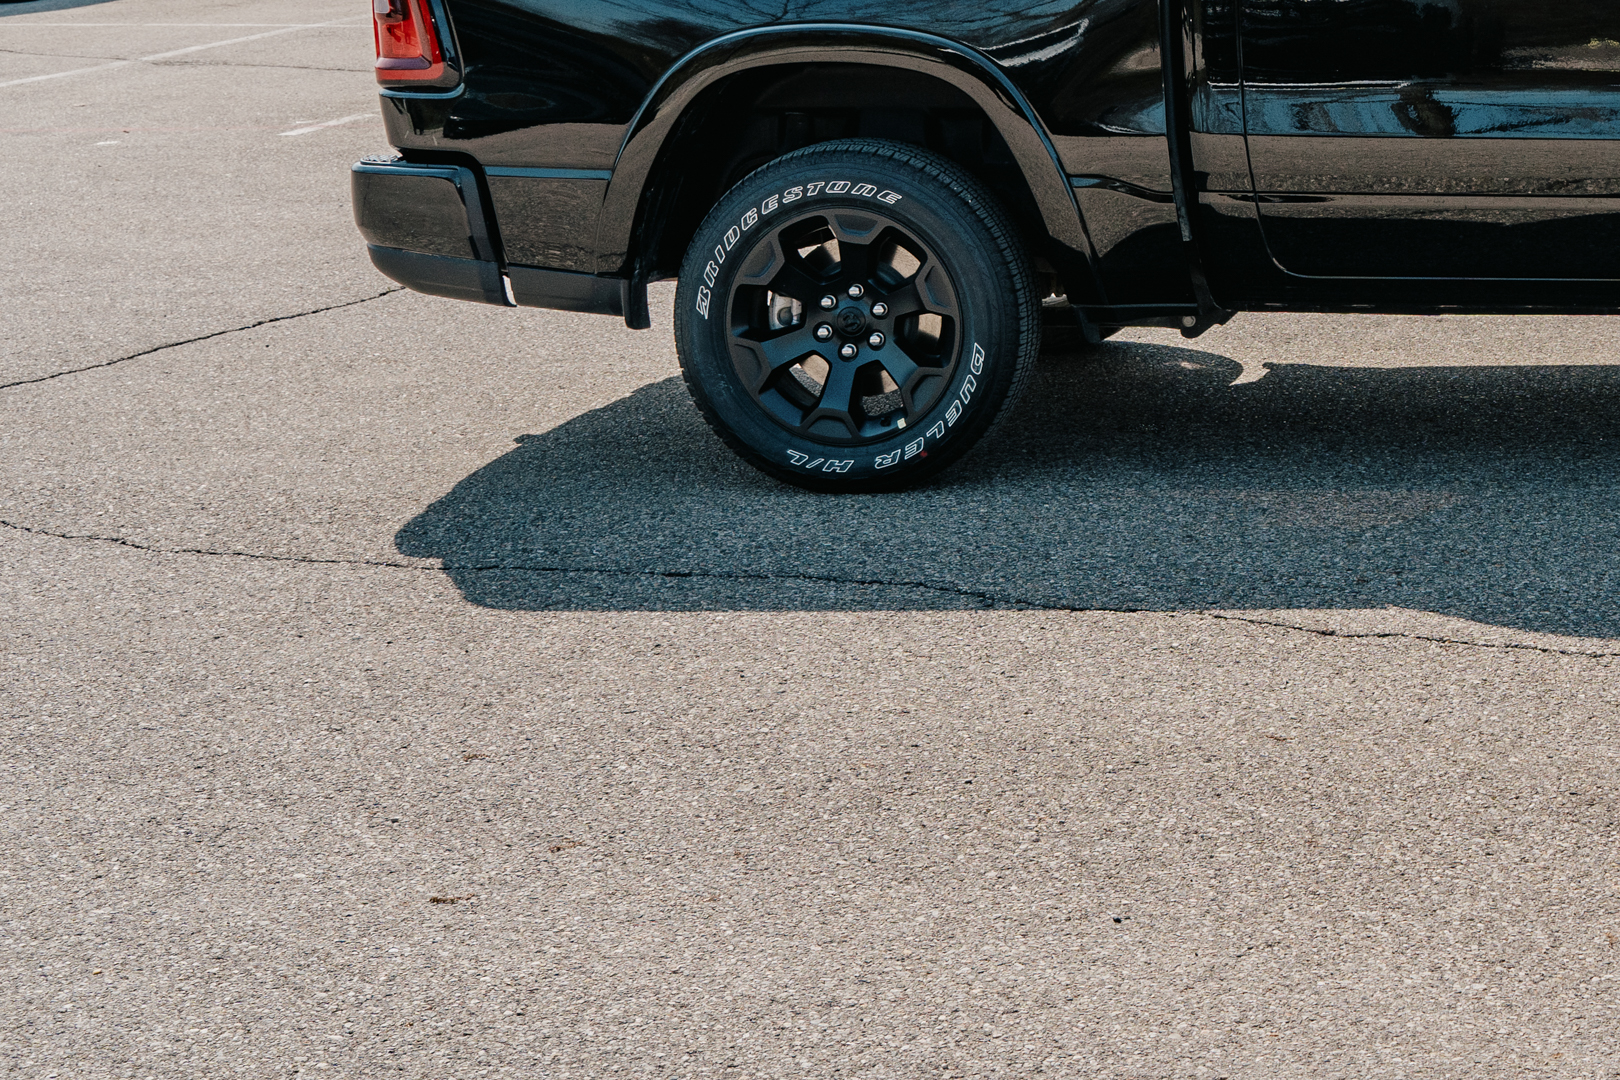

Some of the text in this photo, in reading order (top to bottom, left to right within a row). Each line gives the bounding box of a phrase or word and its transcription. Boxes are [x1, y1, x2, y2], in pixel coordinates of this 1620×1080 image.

[696, 181, 902, 319] BRIDGESTONE
[786, 343, 985, 473] DUELER H/L
